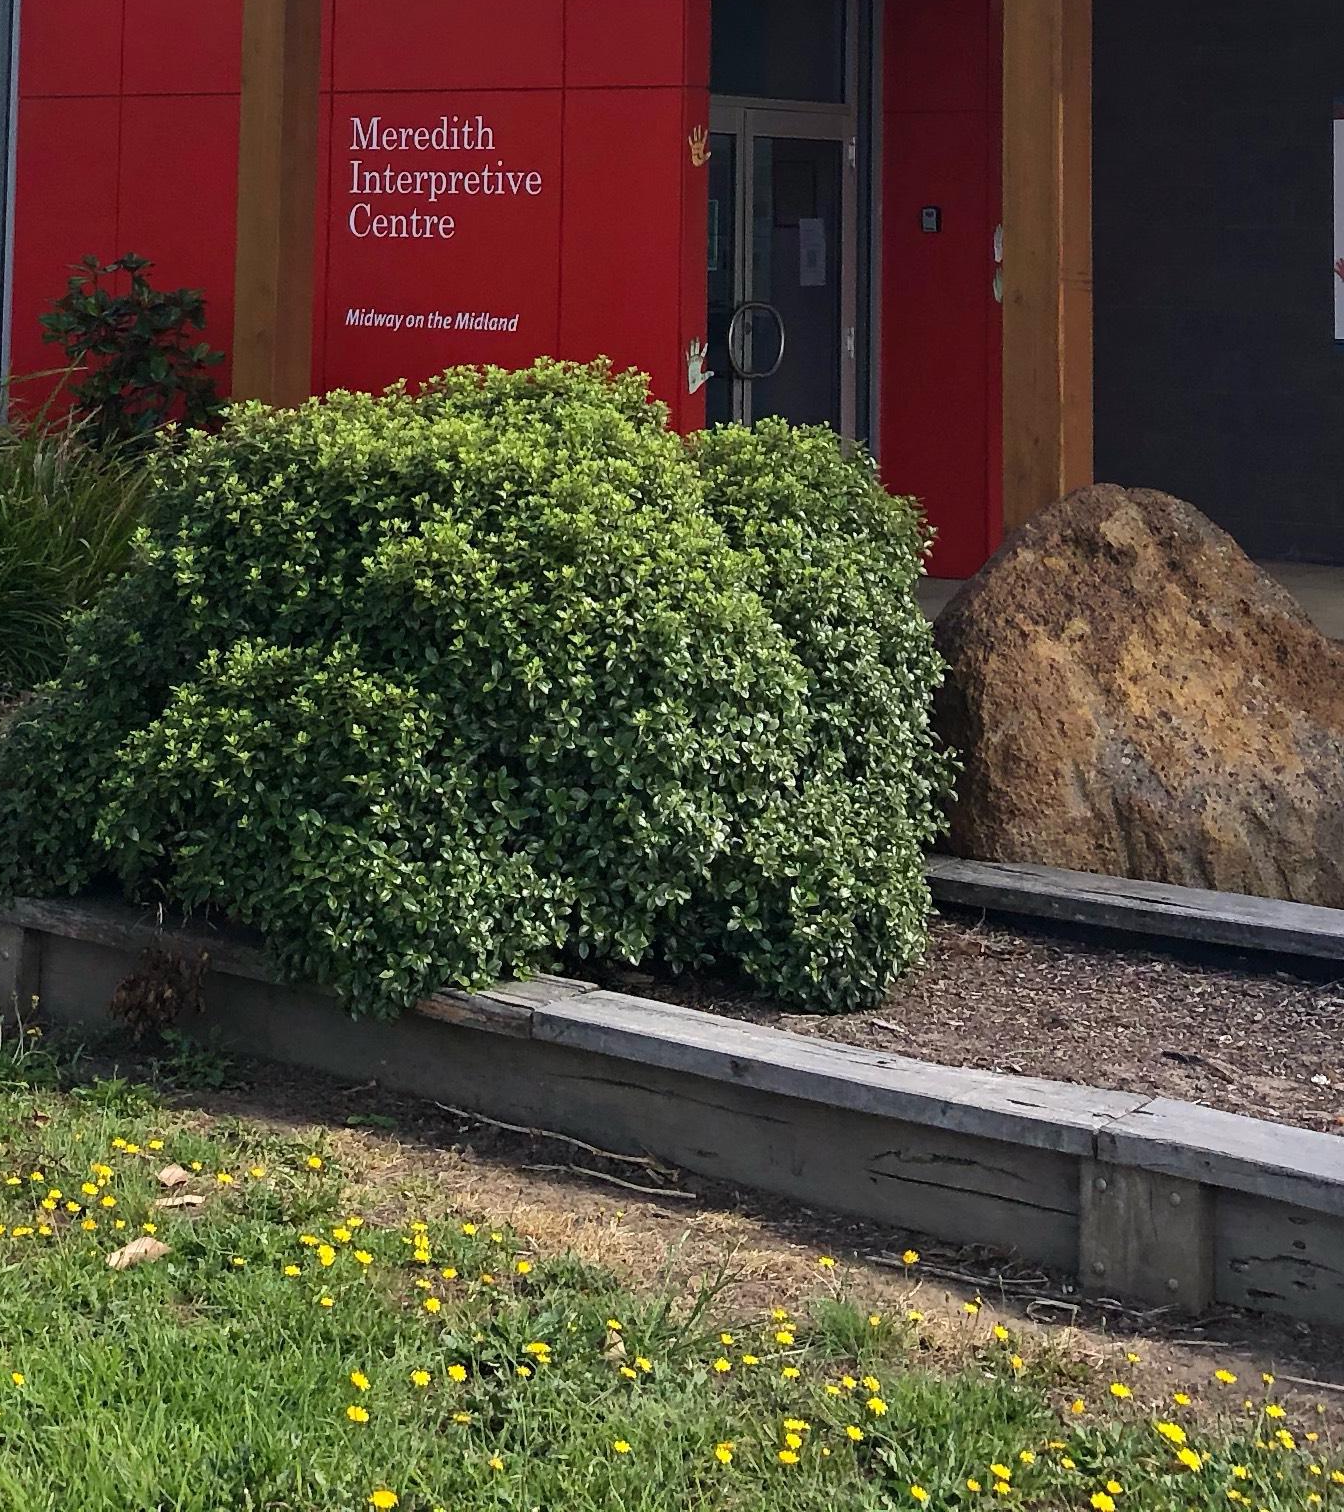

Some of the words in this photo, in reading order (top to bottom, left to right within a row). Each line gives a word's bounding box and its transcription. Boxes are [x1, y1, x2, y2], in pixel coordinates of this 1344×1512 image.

[350, 116, 495, 150] Meredith
[349, 160, 542, 202] Interpretive
[349, 203, 456, 238] Centre
[345, 308, 404, 331] Midway
[406, 314, 424, 328] on
[427, 311, 452, 330] the
[454, 312, 519, 332] Midland
